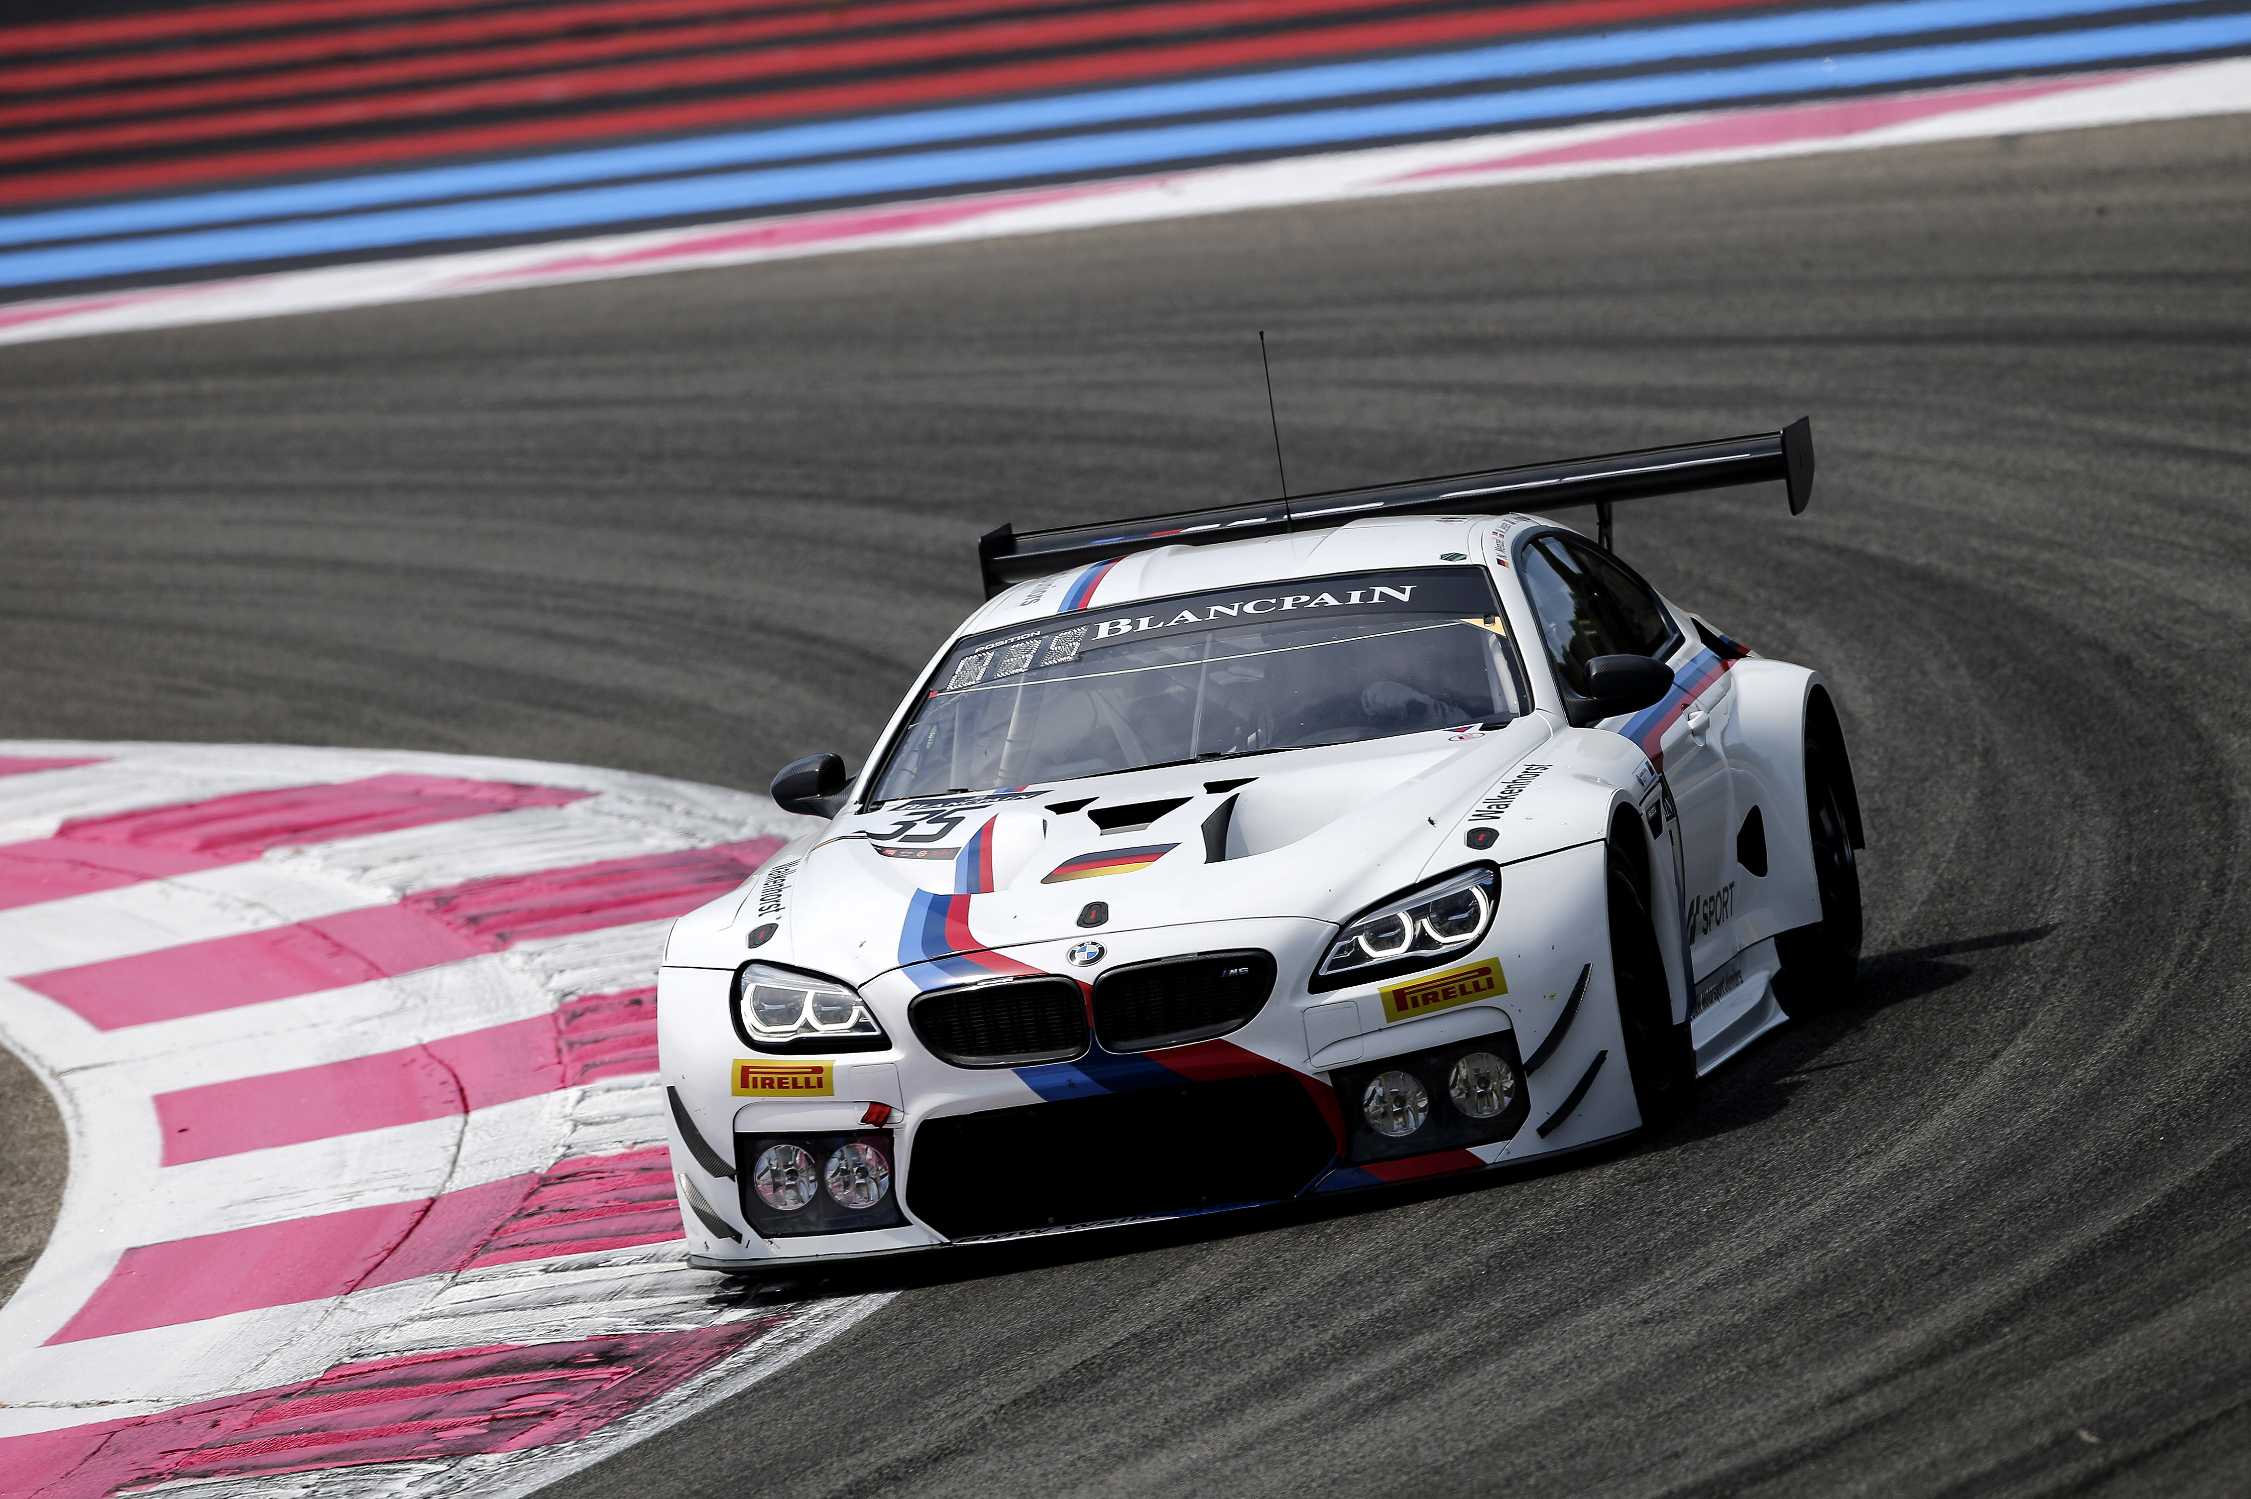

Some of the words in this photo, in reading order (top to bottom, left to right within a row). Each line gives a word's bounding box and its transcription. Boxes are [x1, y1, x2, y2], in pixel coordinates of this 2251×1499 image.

[1091, 585, 1416, 641] BLANCPAIN
[974, 631, 1042, 654] POSITION
[1467, 763, 1553, 822] Walkenhorst
[860, 804, 994, 843] 35
[1702, 881, 1735, 936] SPORT
[1392, 966, 1495, 1013] PIRELLI
[740, 1065, 825, 1090] PIRELLI
